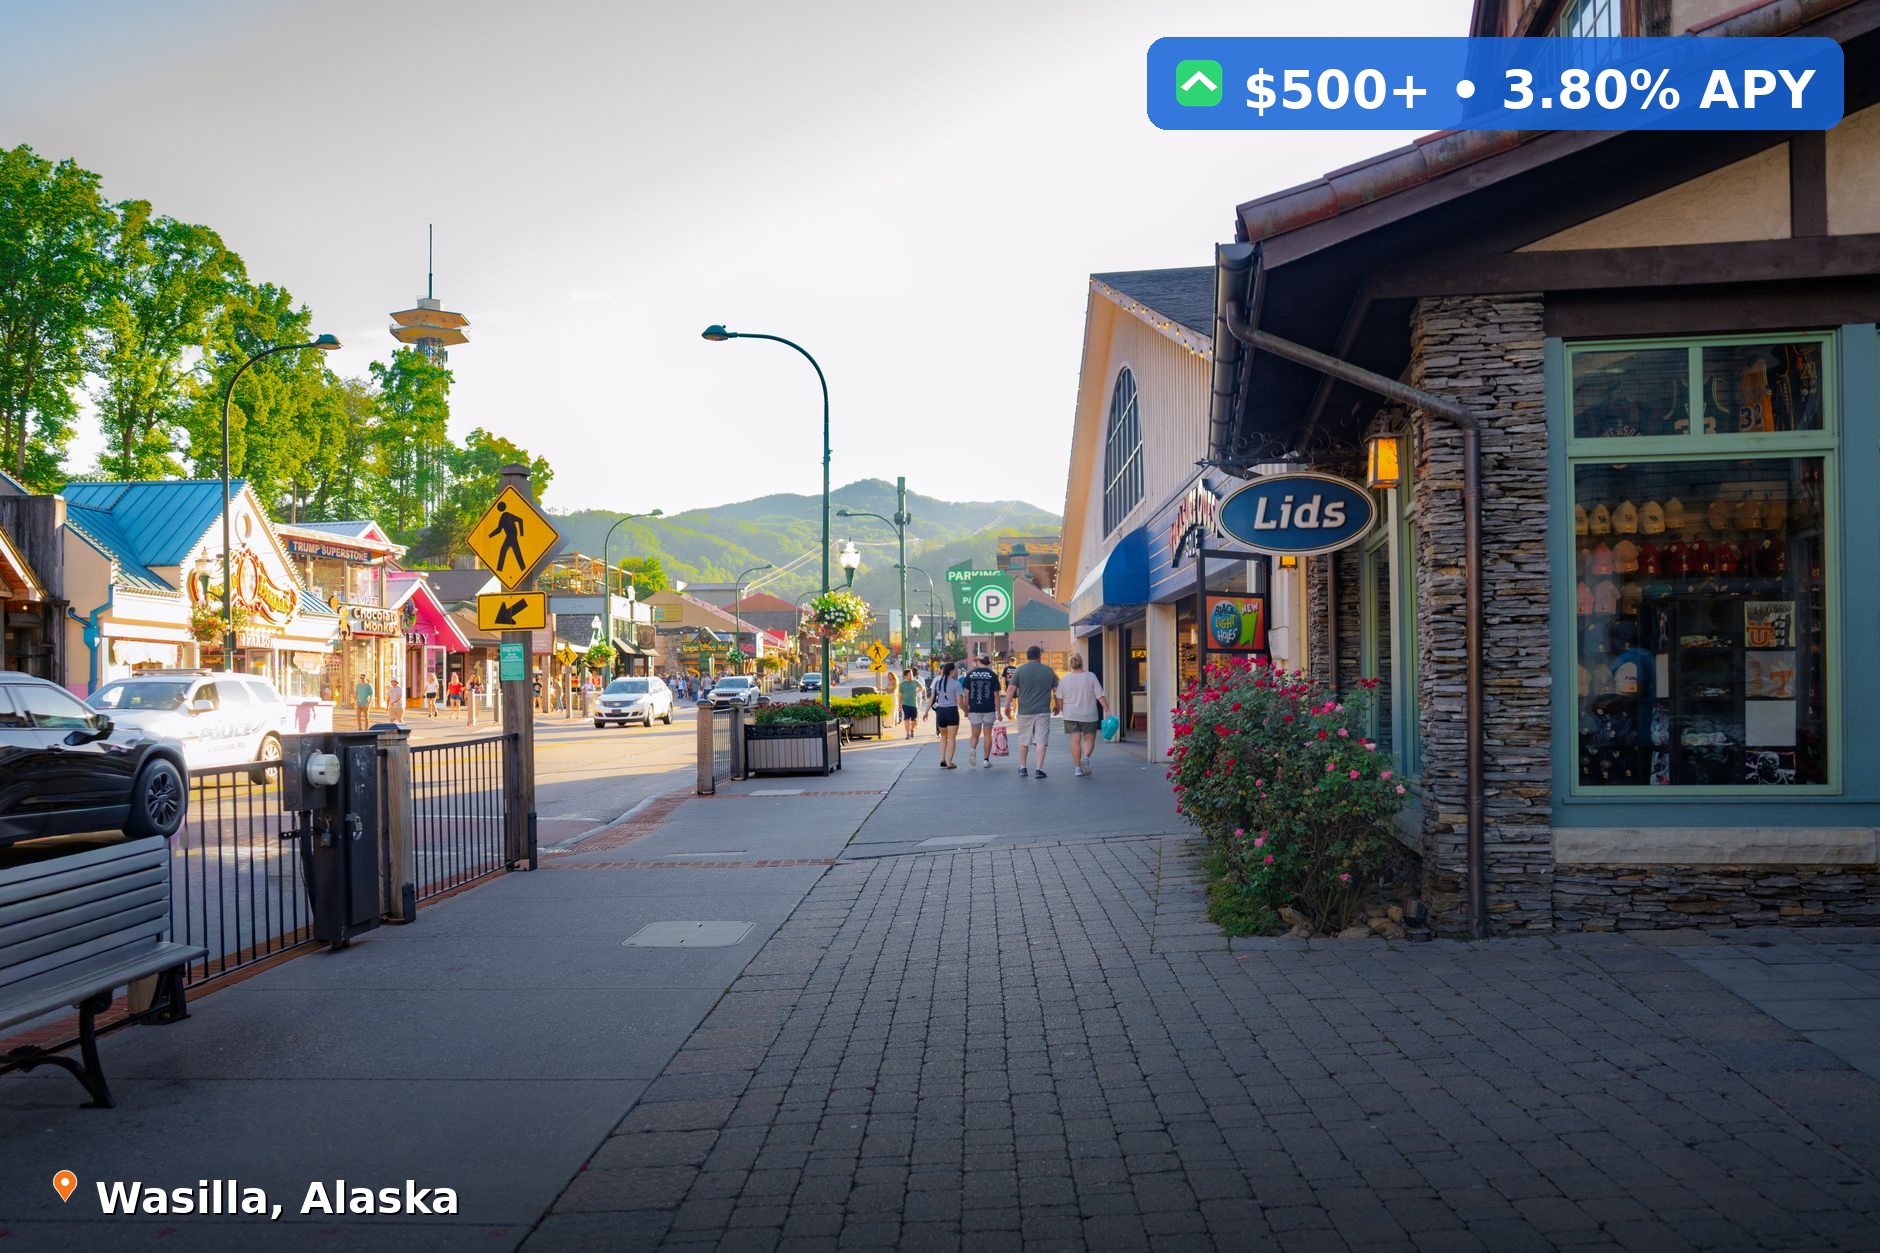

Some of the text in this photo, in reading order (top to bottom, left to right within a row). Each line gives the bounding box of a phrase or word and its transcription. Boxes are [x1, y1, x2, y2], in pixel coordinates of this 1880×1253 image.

[1254, 494, 1346, 530] Lids
[292, 541, 368, 561] TRUMP SUPERSTORE
[986, 595, 1000, 613] P
[1214, 604, 1237, 616] BLACK
[1241, 602, 1259, 615] NEW
[352, 608, 398, 621] Chocolate
[362, 620, 398, 633] Monkey
[1215, 614, 1236, 629] LIGHT
[1217, 628, 1238, 641] HOLES
